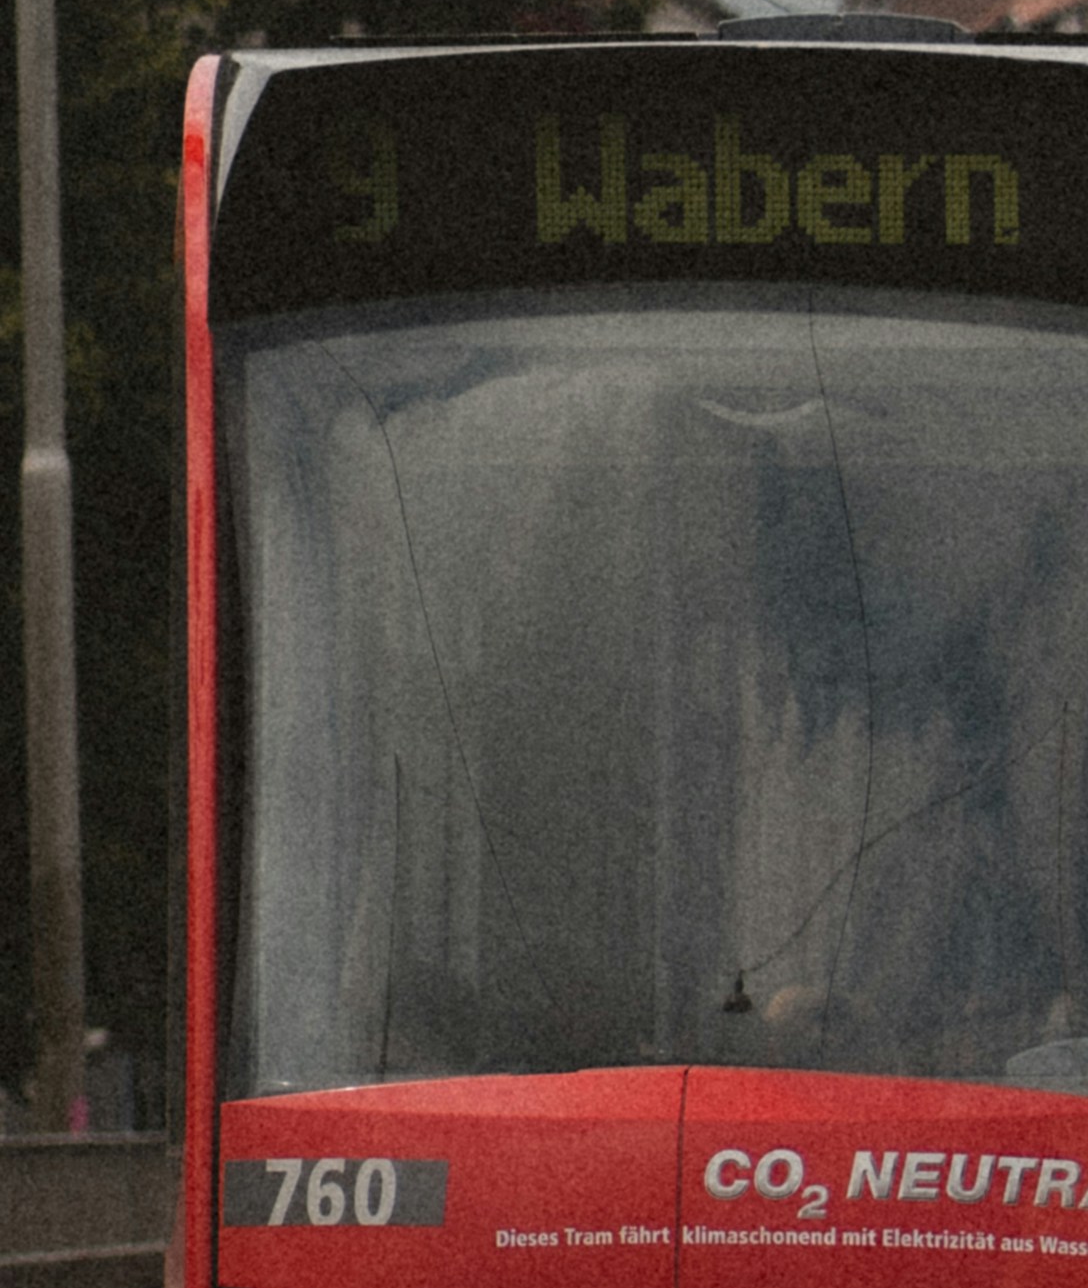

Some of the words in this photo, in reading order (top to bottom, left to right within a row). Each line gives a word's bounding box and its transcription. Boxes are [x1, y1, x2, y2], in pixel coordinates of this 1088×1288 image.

[325, 110, 400, 243] 9
[536, 114, 1020, 244] Wabern
[266, 1158, 396, 1226] 760
[496, 1229, 558, 1247] Dieses
[564, 1228, 612, 1245] Tram
[619, 1226, 669, 1245] fährt
[683, 1226, 836, 1245] klimaschonend
[842, 1229, 876, 1246] mit
[882, 1229, 995, 1250] Elektrizität
[1001, 1237, 1033, 1252] aus
